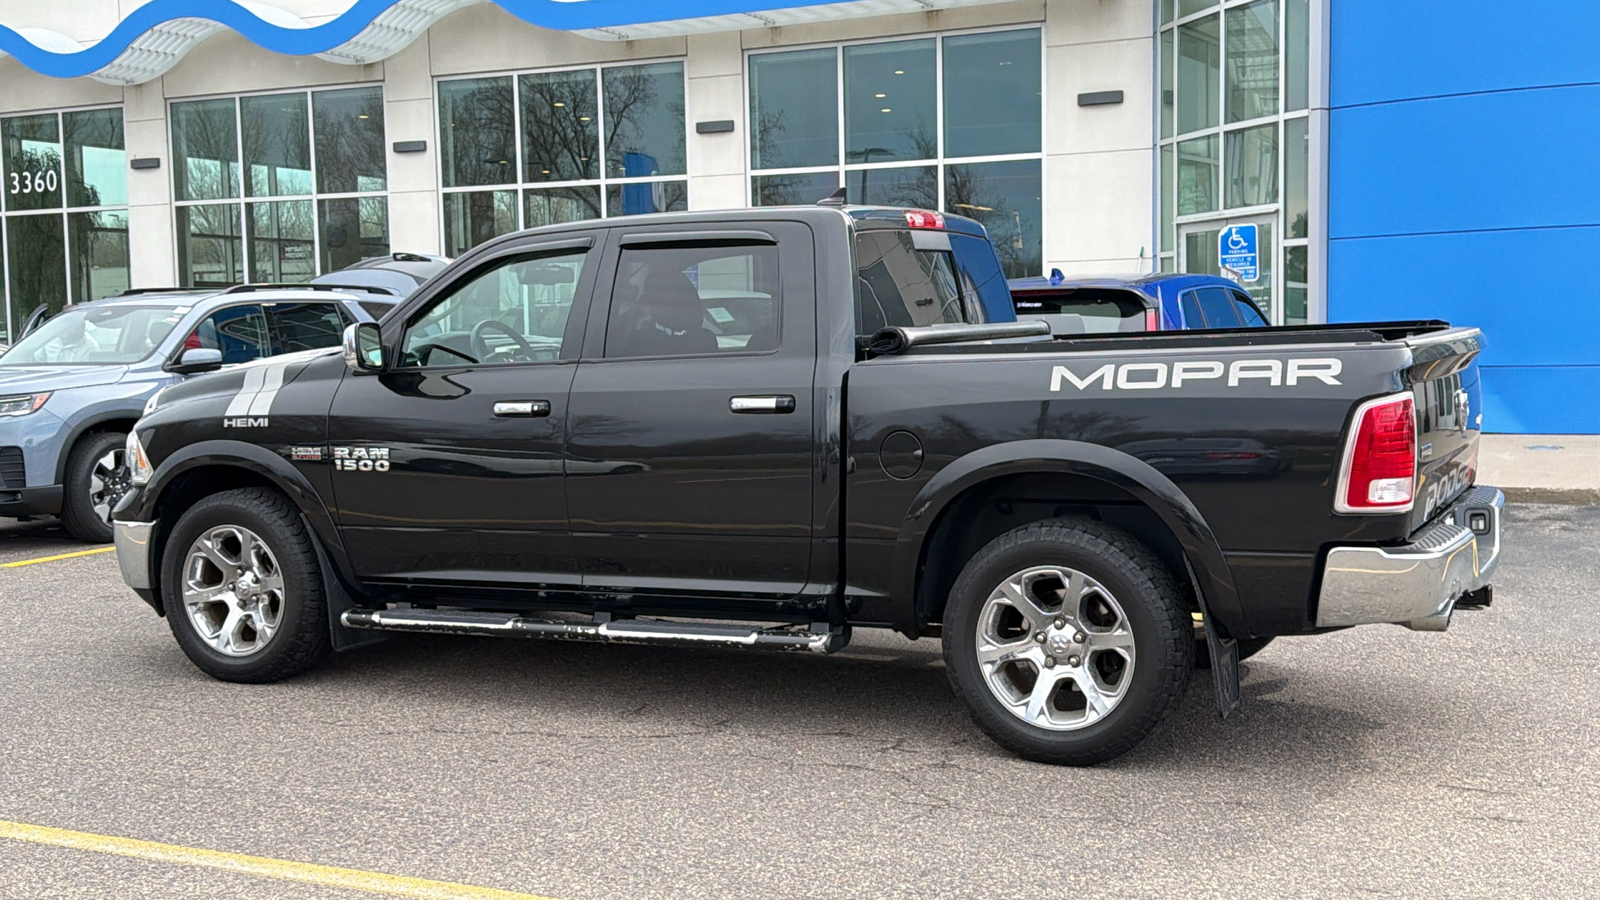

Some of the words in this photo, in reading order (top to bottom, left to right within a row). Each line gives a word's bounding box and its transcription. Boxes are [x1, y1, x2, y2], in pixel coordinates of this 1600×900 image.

[10, 169, 57, 194] 3360
[1050, 358, 1343, 392] MOPAR
[223, 418, 268, 427] HEMI
[334, 447, 389, 459] RAM
[335, 460, 390, 472] 1500
